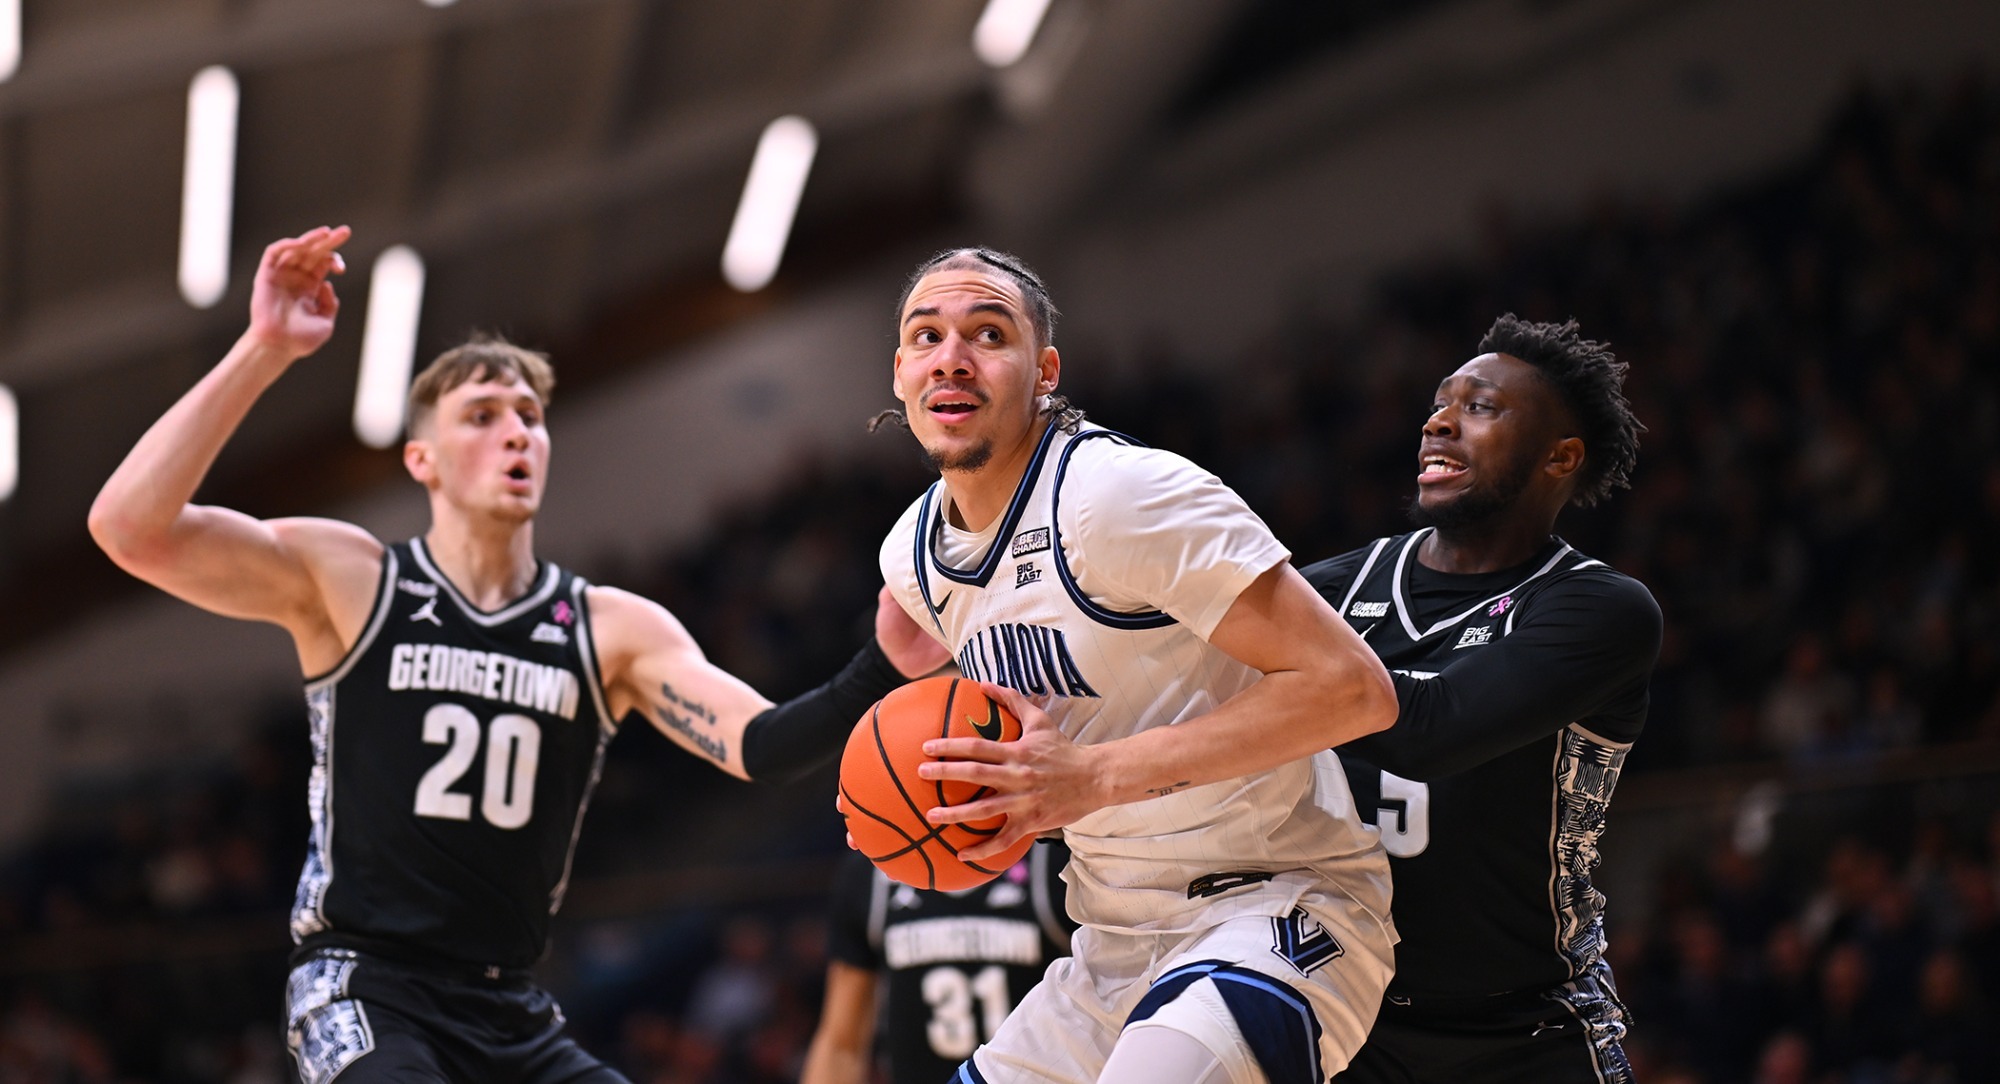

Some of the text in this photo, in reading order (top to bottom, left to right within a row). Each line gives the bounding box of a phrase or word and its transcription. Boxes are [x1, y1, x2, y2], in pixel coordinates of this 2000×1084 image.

[1013, 540, 1049, 556] CHANGE
[1016, 561, 1034, 576] BIG
[1016, 569, 1043, 585] EAST
[1458, 632, 1493, 645] EAST
[1463, 625, 1490, 637] BIG
[388, 643, 580, 721] GEORGETOWN
[413, 703, 542, 830] 20
[1376, 768, 1430, 859] 5
[921, 965, 1012, 1061] 31
